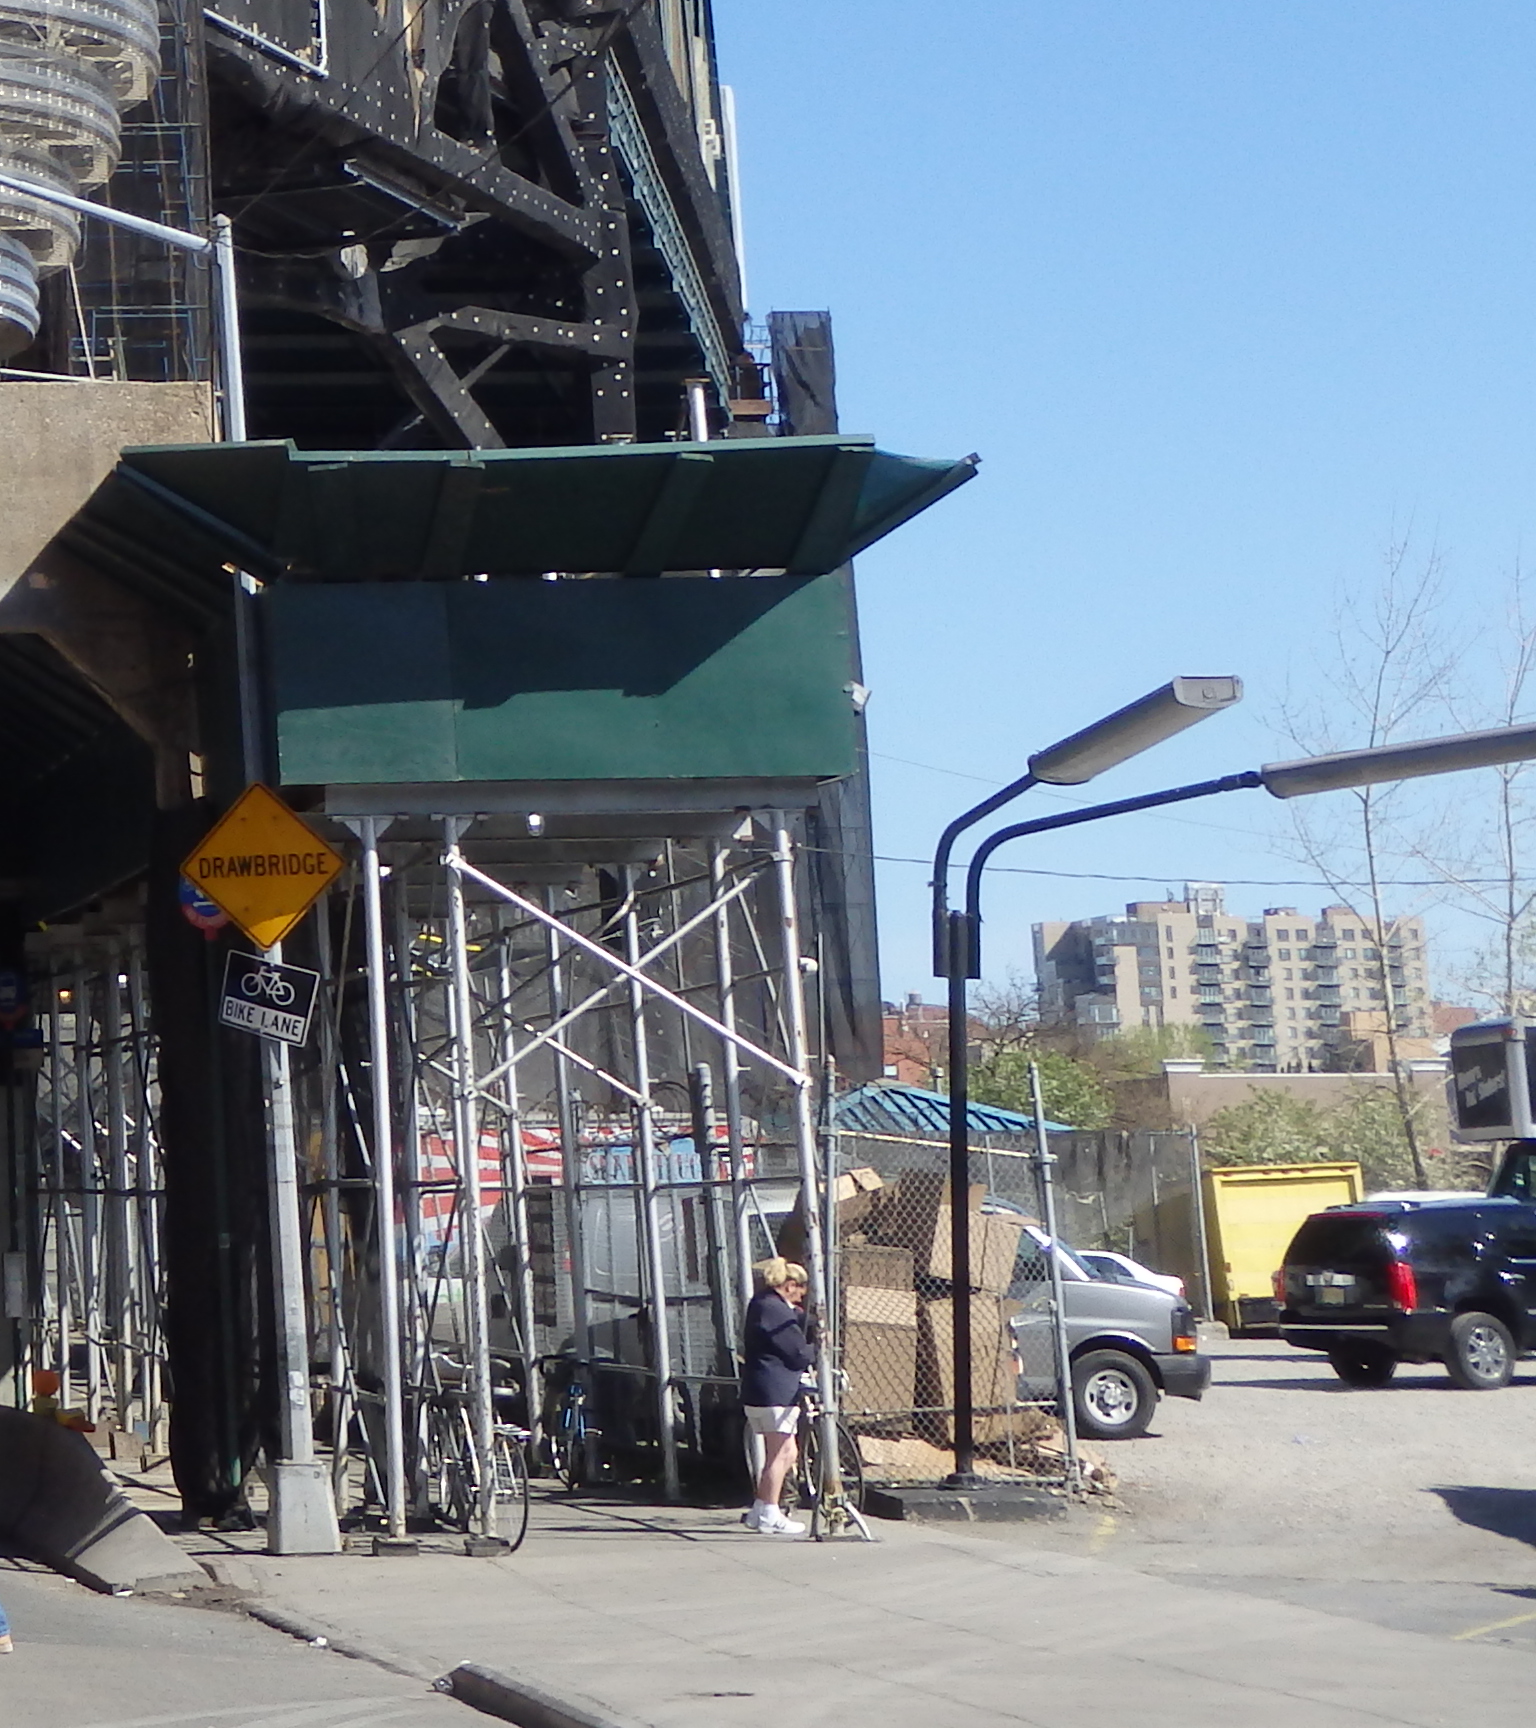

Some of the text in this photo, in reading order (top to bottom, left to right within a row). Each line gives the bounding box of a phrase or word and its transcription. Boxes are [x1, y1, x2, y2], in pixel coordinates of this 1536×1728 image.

[199, 853, 329, 879] DRAWBRIDGE
[225, 999, 302, 1038] BIKE LANE
